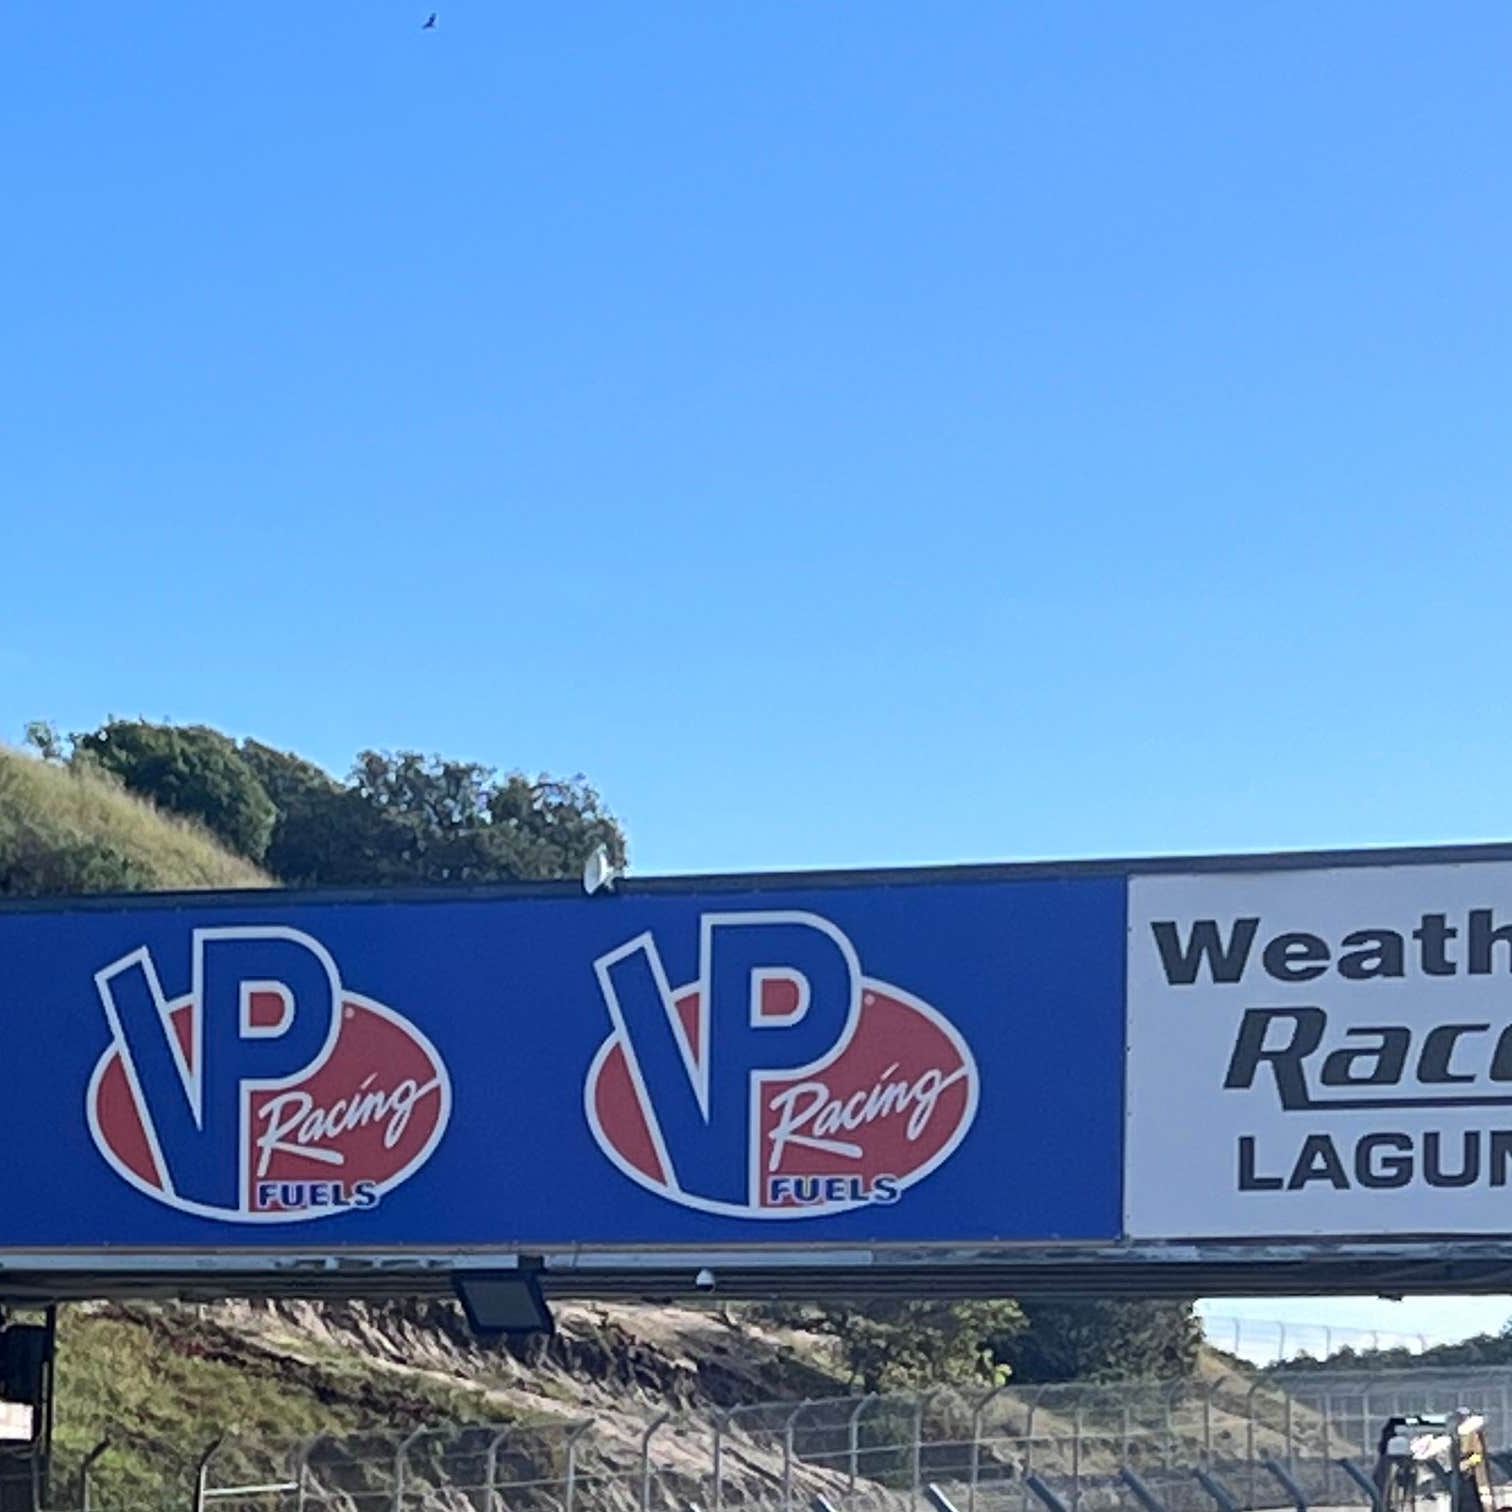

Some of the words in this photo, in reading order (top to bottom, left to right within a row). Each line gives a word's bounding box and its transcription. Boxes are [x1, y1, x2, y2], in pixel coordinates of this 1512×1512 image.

[94, 926, 342, 1216] VP
[593, 910, 863, 1212] VP
[257, 1072, 441, 1178] Racing
[768, 1062, 966, 1172] Racing
[256, 1180, 382, 1211] FUELS
[768, 1173, 902, 1206] FUELS
